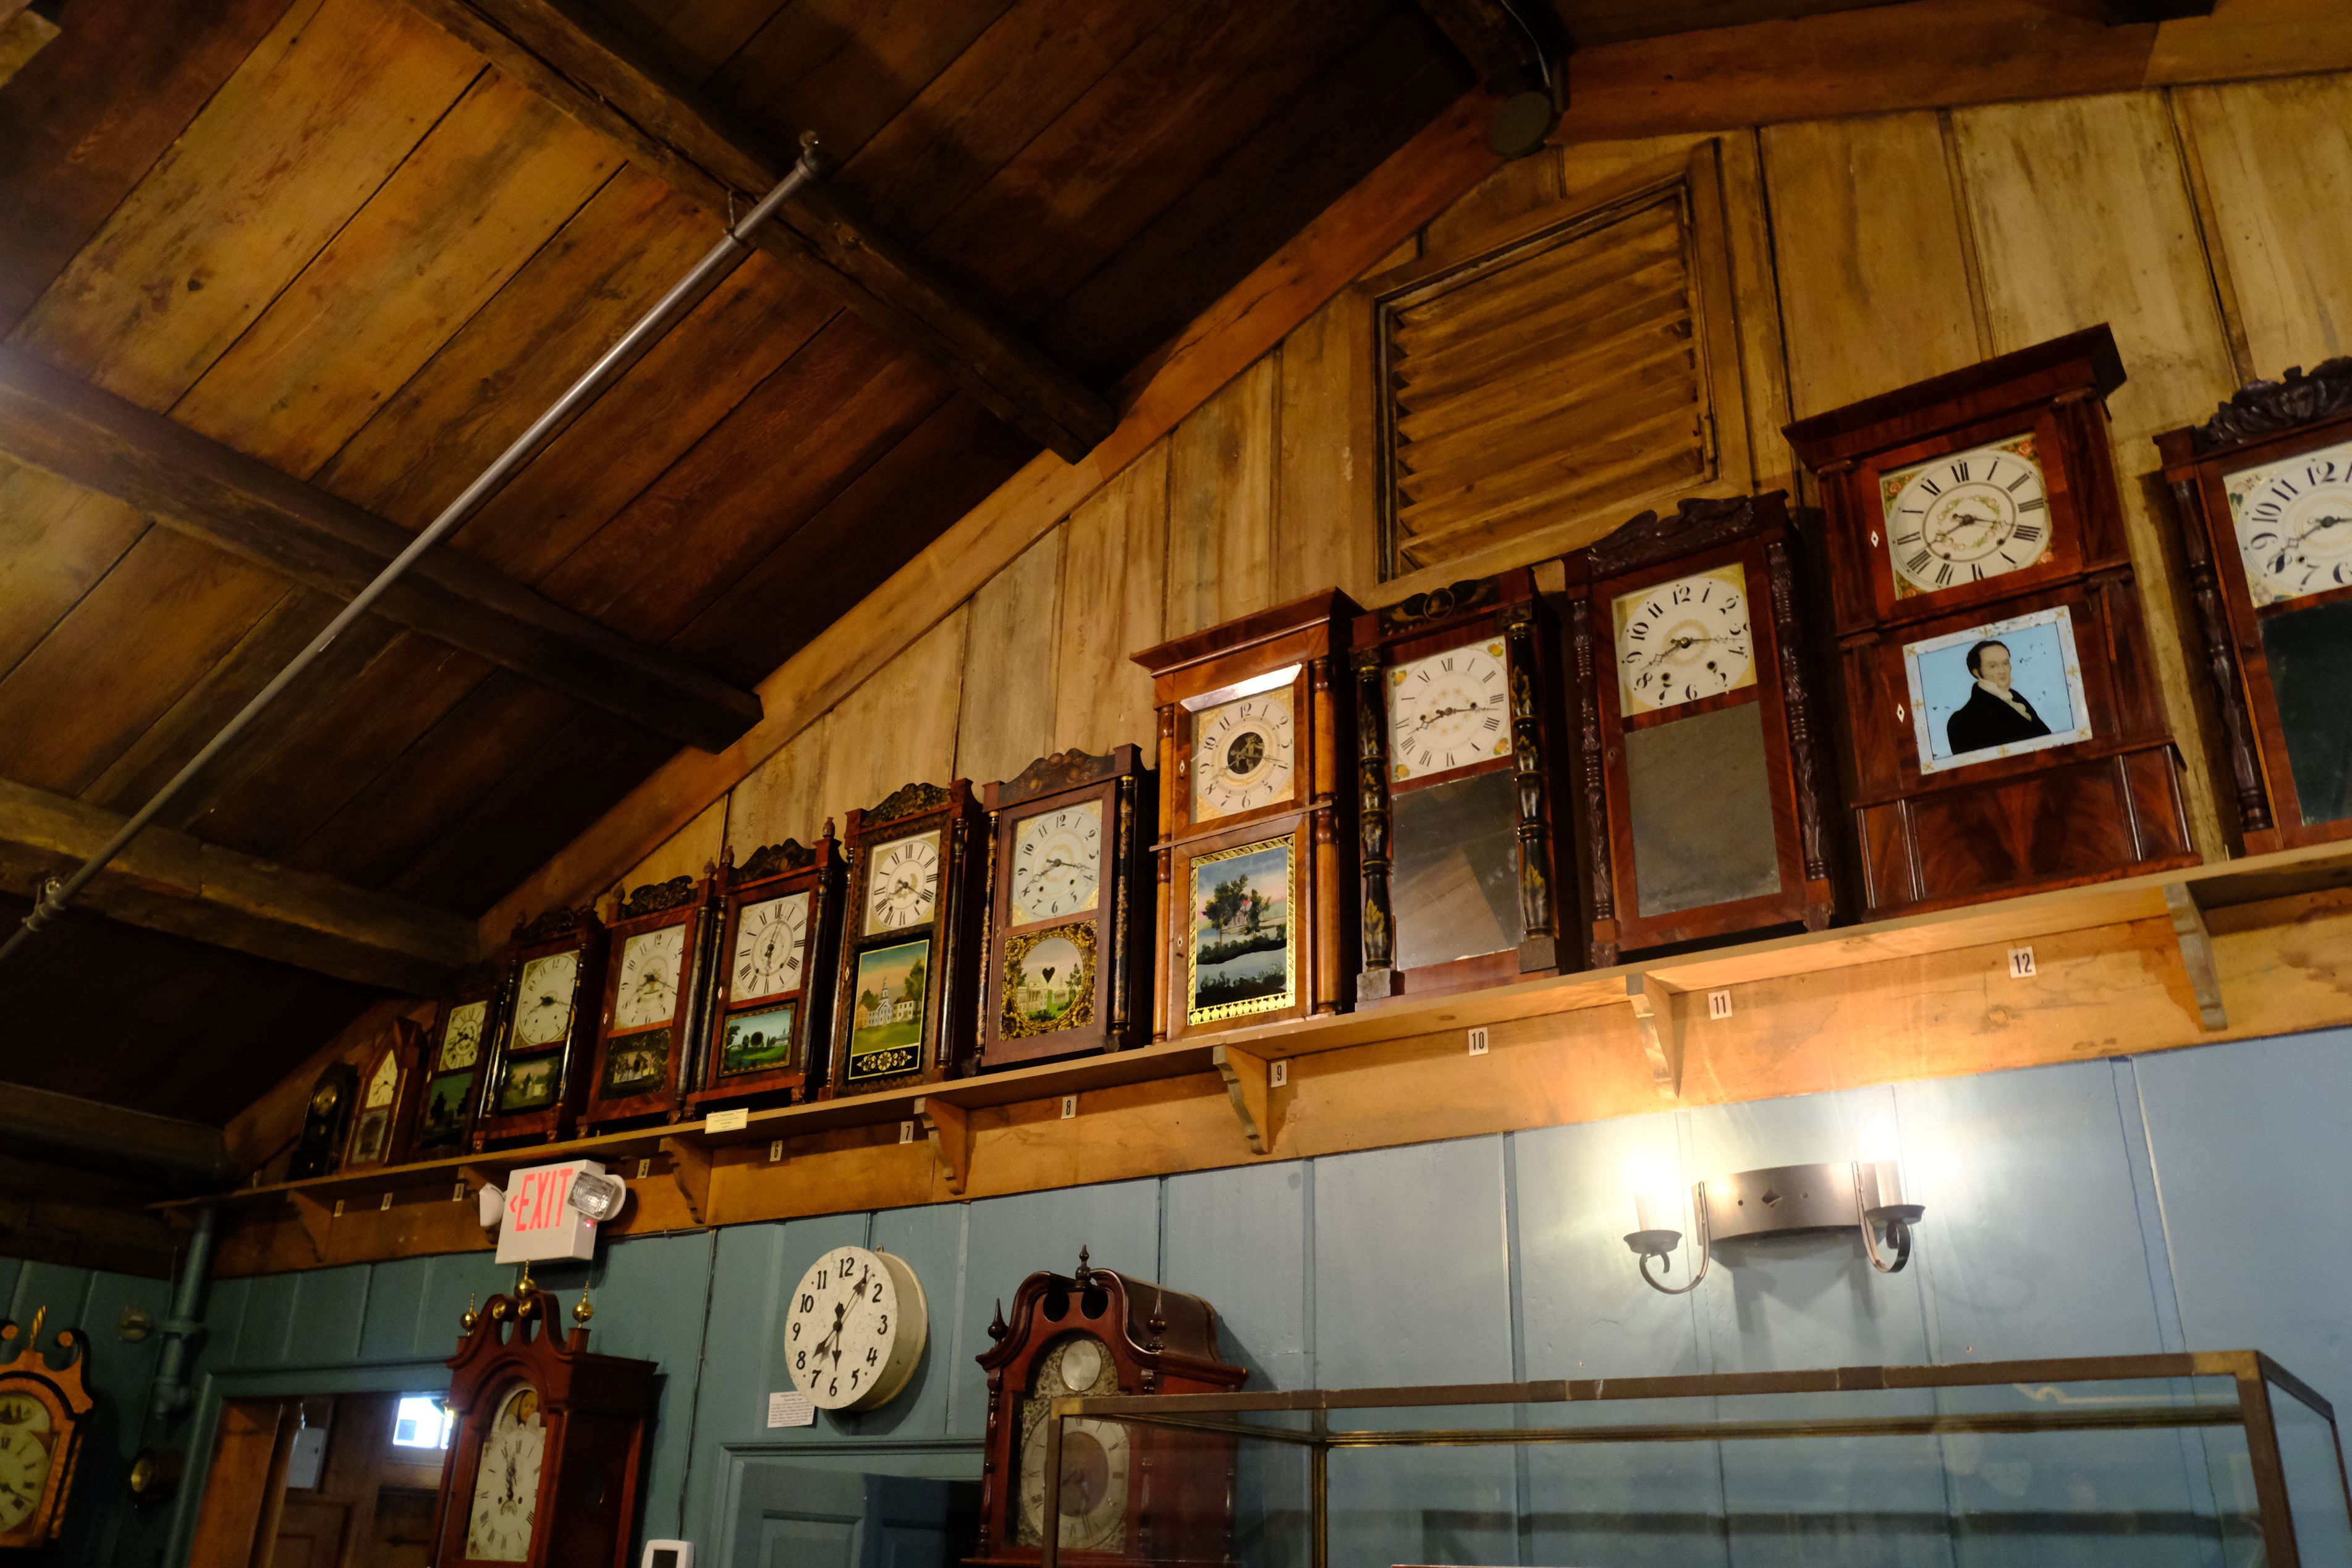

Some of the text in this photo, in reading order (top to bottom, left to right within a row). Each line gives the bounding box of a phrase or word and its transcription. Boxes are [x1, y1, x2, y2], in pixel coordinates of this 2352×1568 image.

[1987, 461, 1997, 481] I
[2307, 462, 2336, 486] 12
[2007, 473, 2030, 493] II
[2270, 478, 2299, 502] 11
[2018, 497, 2044, 513] III
[2251, 502, 2282, 523] 10
[2251, 532, 2278, 550] 9
[2267, 554, 2292, 574] 8
[2300, 564, 2320, 586] 7
[1673, 586, 1691, 605] 12
[1702, 588, 1710, 603] 1
[1648, 602, 1664, 618] 11
[1719, 597, 1737, 615] 2
[1630, 622, 1649, 641] 10
[1467, 657, 1475, 672] I
[1626, 651, 1643, 664] 9
[1482, 670, 1497, 684] II
[1636, 672, 1653, 689] 8
[1489, 693, 1504, 704] III
[1659, 683, 1672, 701] 7
[1685, 683, 1698, 701] 6
[1240, 702, 1252, 718] 12
[1262, 704, 1269, 717] 1
[1219, 716, 1230, 731] 11
[1275, 715, 1288, 730] 2
[1204, 736, 1216, 750] 10
[1198, 762, 1211, 774] 9
[1205, 782, 1216, 796] 8
[1220, 793, 1232, 807] 7
[1242, 794, 1251, 808] 6
[1056, 814, 1066, 828] 12
[1074, 816, 1081, 829] 1
[1038, 825, 1047, 838] 11
[1085, 829, 1096, 841] 2
[917, 845, 925, 860] I
[1023, 843, 1034, 856] 10
[924, 856, 936, 869] II
[926, 873, 938, 883] III
[1017, 867, 1028, 876] 9
[1020, 886, 1031, 897] 8
[1032, 898, 1043, 910] 7
[1051, 901, 1058, 914] 6
[787, 906, 795, 921] I
[793, 919, 805, 932] II
[654, 934, 662, 946] 12
[793, 939, 805, 948] III
[2013, 953, 2033, 974] 12
[1714, 995, 1726, 1014] 11
[1472, 1031, 1484, 1050] 10
[1277, 1064, 1282, 1081] 9
[1066, 1100, 1071, 1115] 8
[906, 1125, 910, 1140] 7
[774, 1144, 779, 1158] 6
[514, 1168, 573, 1233] EXIT
[839, 1257, 855, 1278] 12
[816, 1270, 827, 1291] 11
[872, 1283, 883, 1303] 2
[799, 1293, 814, 1313] 10
[792, 1321, 801, 1341] 9
[877, 1314, 888, 1335] 3
[796, 1350, 806, 1370] 8
[866, 1347, 878, 1367] 4
[810, 1369, 822, 1389] 7
[829, 1377, 837, 1397] 6
[851, 1368, 860, 1391] 5
